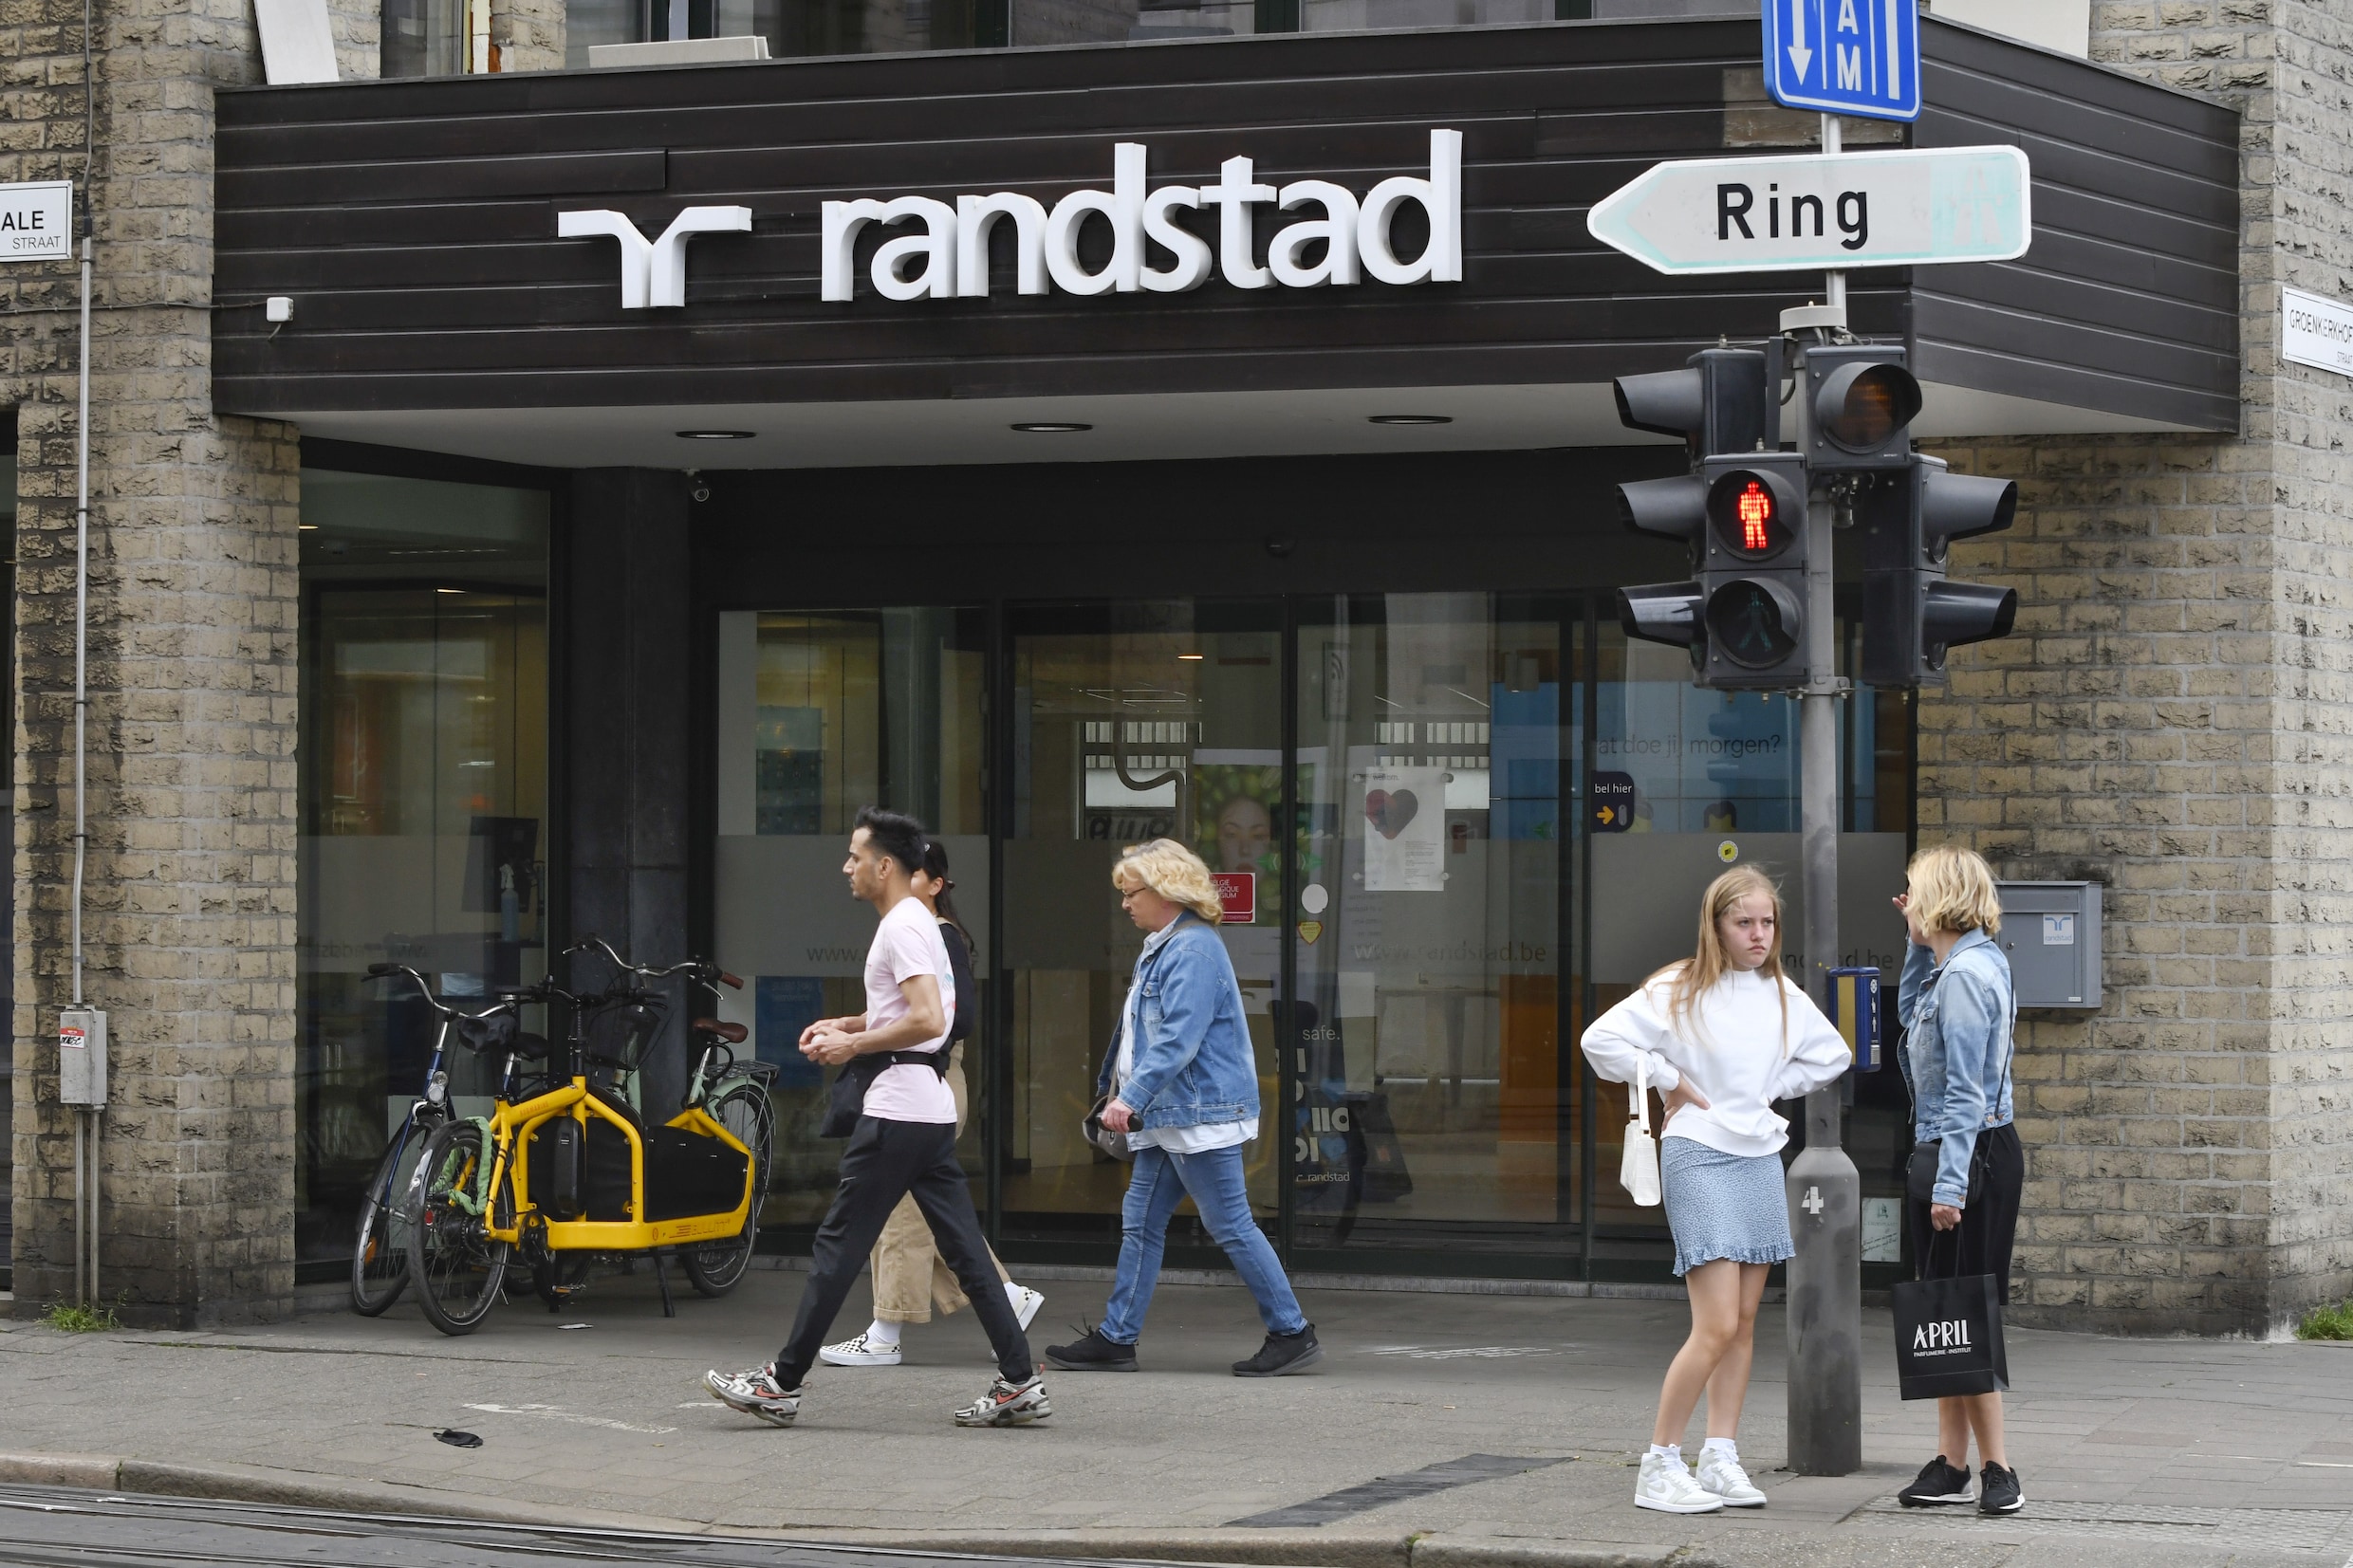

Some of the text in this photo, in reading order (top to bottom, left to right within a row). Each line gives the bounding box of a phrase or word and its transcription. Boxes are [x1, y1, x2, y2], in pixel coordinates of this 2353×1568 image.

[1, 210, 45, 231] ALE
[822, 129, 1463, 302] randstad
[1716, 182, 1869, 250] Ring
[12, 235, 62, 249] STRAAT
[1622, 733, 1661, 754] doe
[1690, 734, 1781, 757] morgen?
[1594, 783, 1633, 795] bel hier
[2045, 933, 2073, 942] randstad
[1302, 1024, 1341, 1042] safe.
[1306, 1171, 1350, 1183] randstad
[1802, 1186, 1825, 1214] 4
[1913, 1319, 1972, 1349] APRIL
